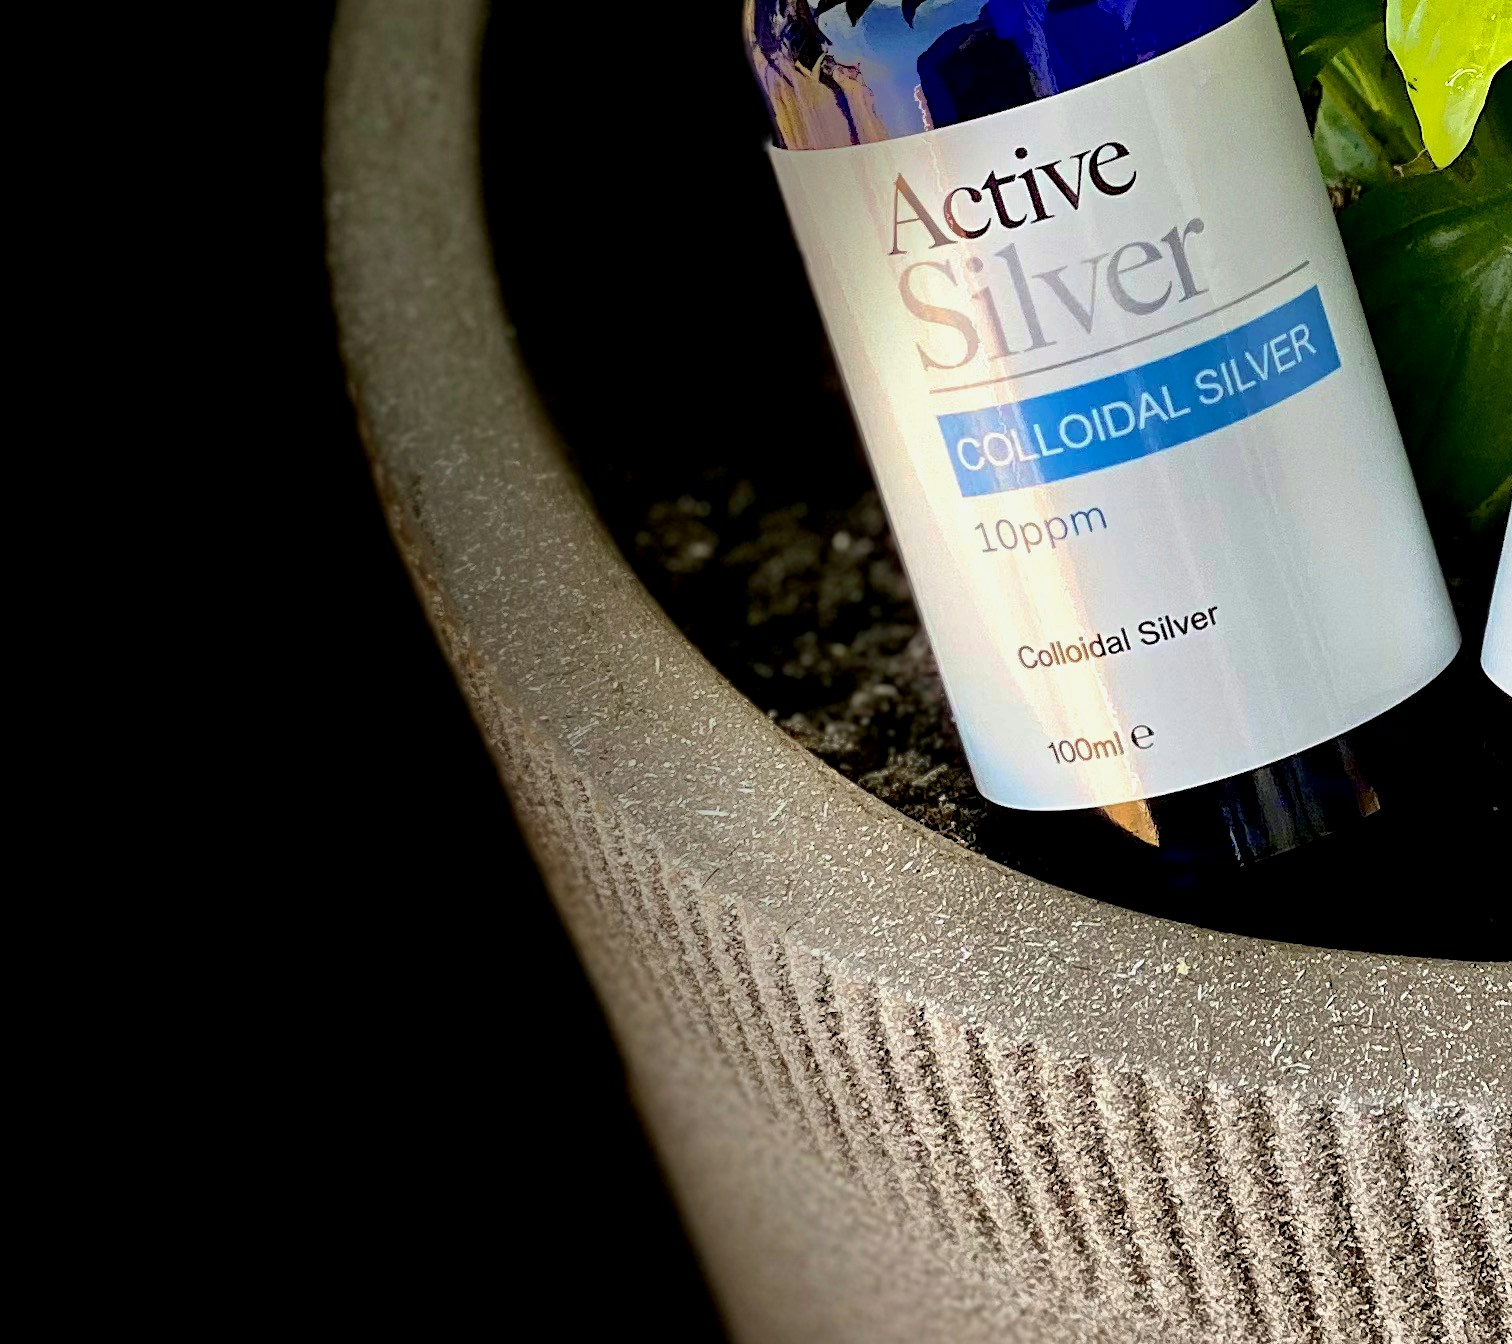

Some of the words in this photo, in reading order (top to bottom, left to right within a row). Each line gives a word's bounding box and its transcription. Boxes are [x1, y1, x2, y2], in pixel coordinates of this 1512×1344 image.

[889, 138, 1138, 256] Active
[897, 216, 1207, 375] Silver
[957, 386, 1192, 472] COLLOIDAL
[1195, 323, 1317, 407] SILVER
[974, 505, 1108, 554] 10ppm
[1017, 628, 1130, 672] Colloidal
[1137, 605, 1219, 646] Silver
[1047, 732, 1124, 766] 100ml
